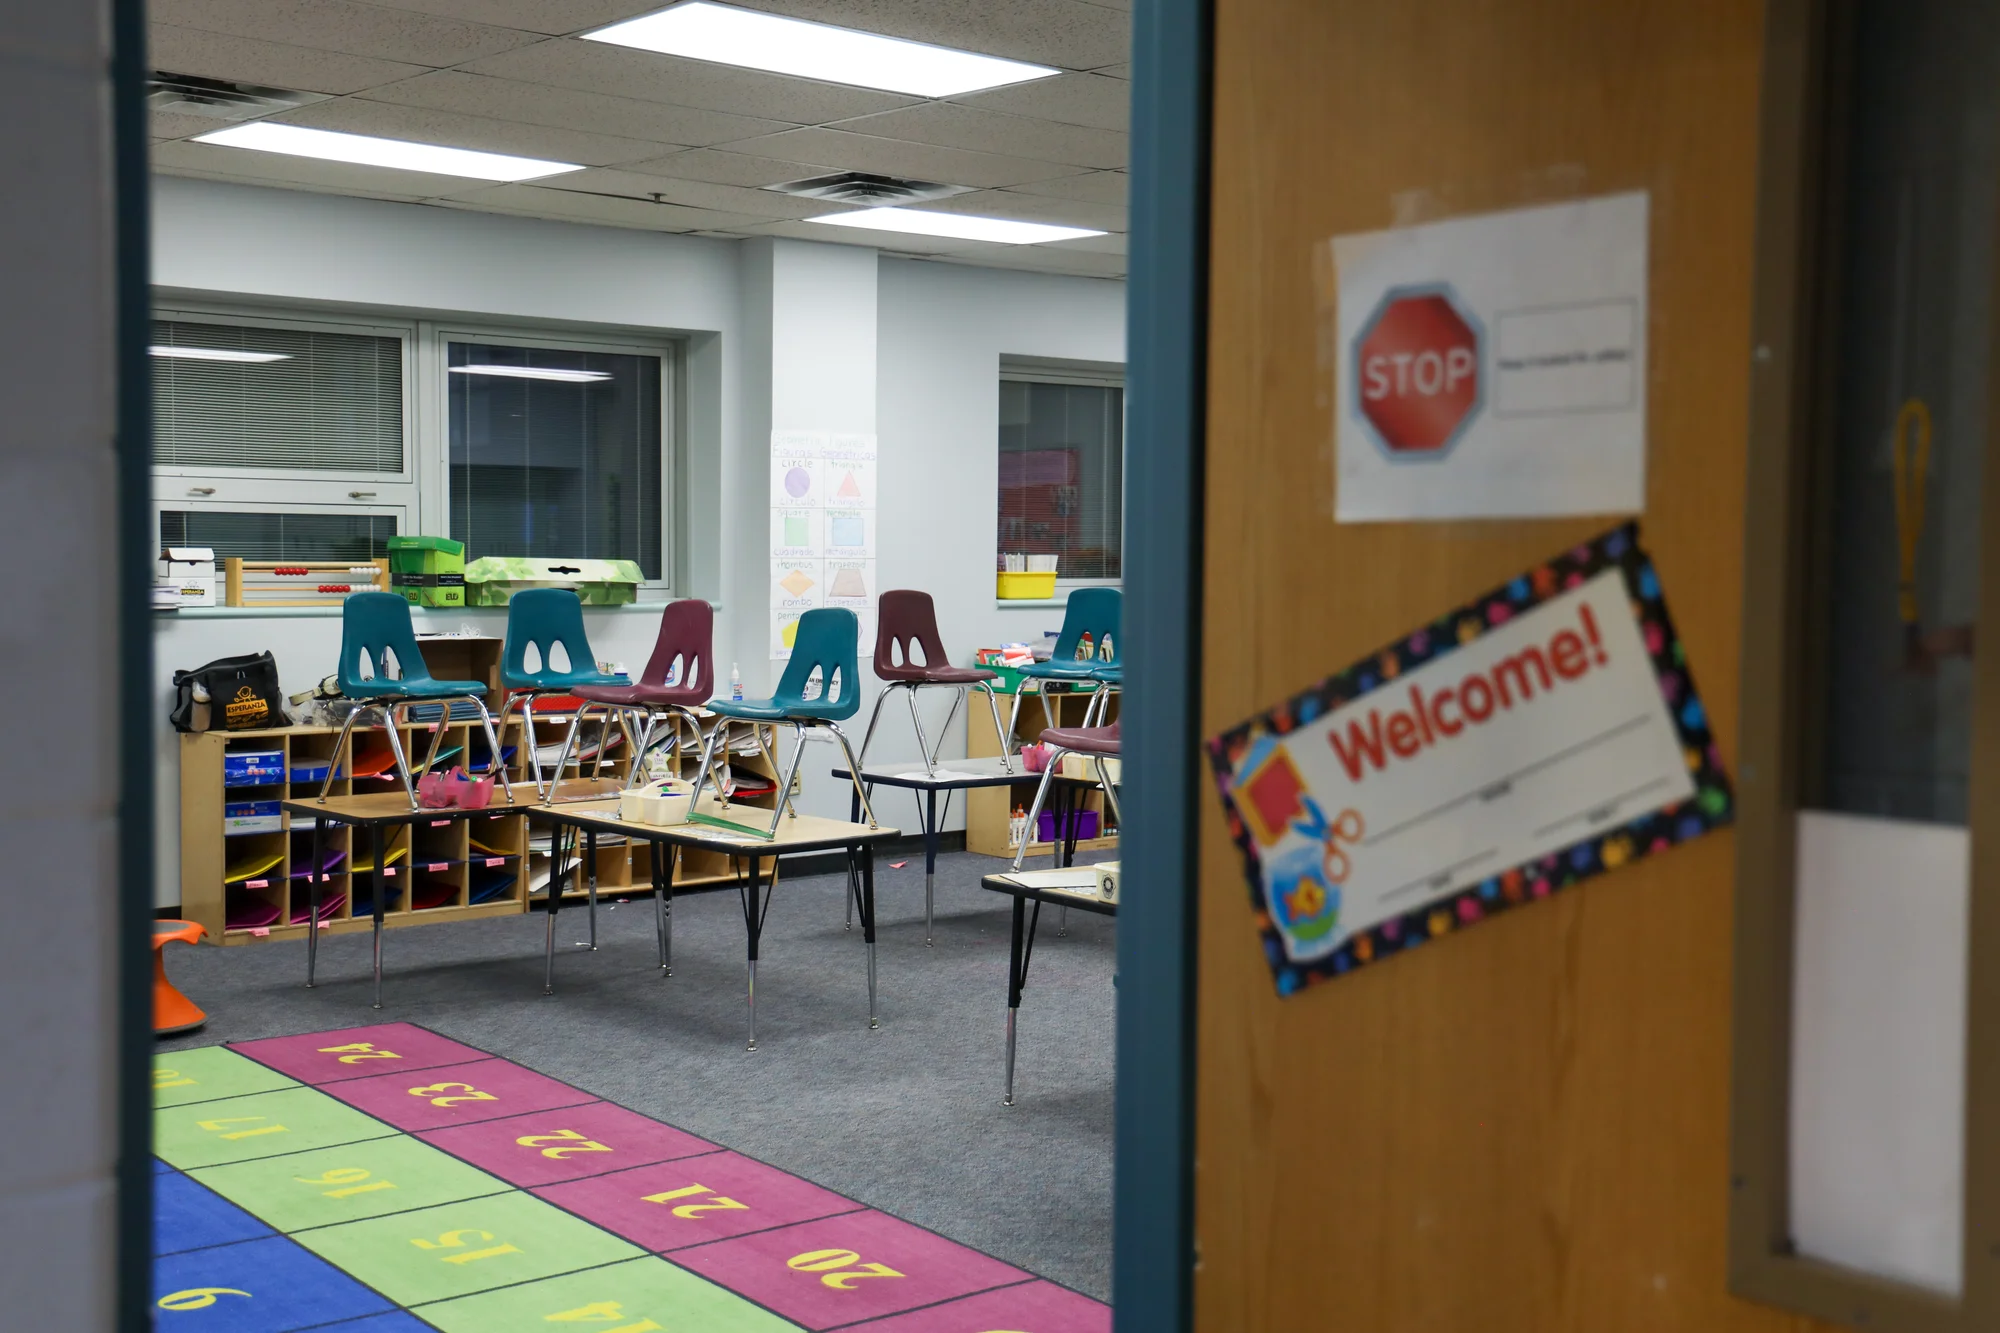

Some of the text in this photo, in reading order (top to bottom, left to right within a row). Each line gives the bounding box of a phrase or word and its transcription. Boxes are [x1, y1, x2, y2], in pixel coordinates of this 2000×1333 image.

[1365, 347, 1474, 400] STOP
[781, 458, 813, 469] circle
[782, 597, 813, 607] rombo
[777, 611, 800, 622] penta
[1328, 602, 1608, 782] Welcome!
[227, 701, 266, 713] ESPERANZA
[317, 1042, 402, 1064] 24
[408, 1082, 499, 1108] 23
[195, 1116, 291, 1140] 17
[516, 1129, 614, 1160] 22
[293, 1167, 398, 1199] 16
[640, 1182, 750, 1219] 21
[410, 1228, 525, 1265] 15
[786, 1248, 907, 1290] 20
